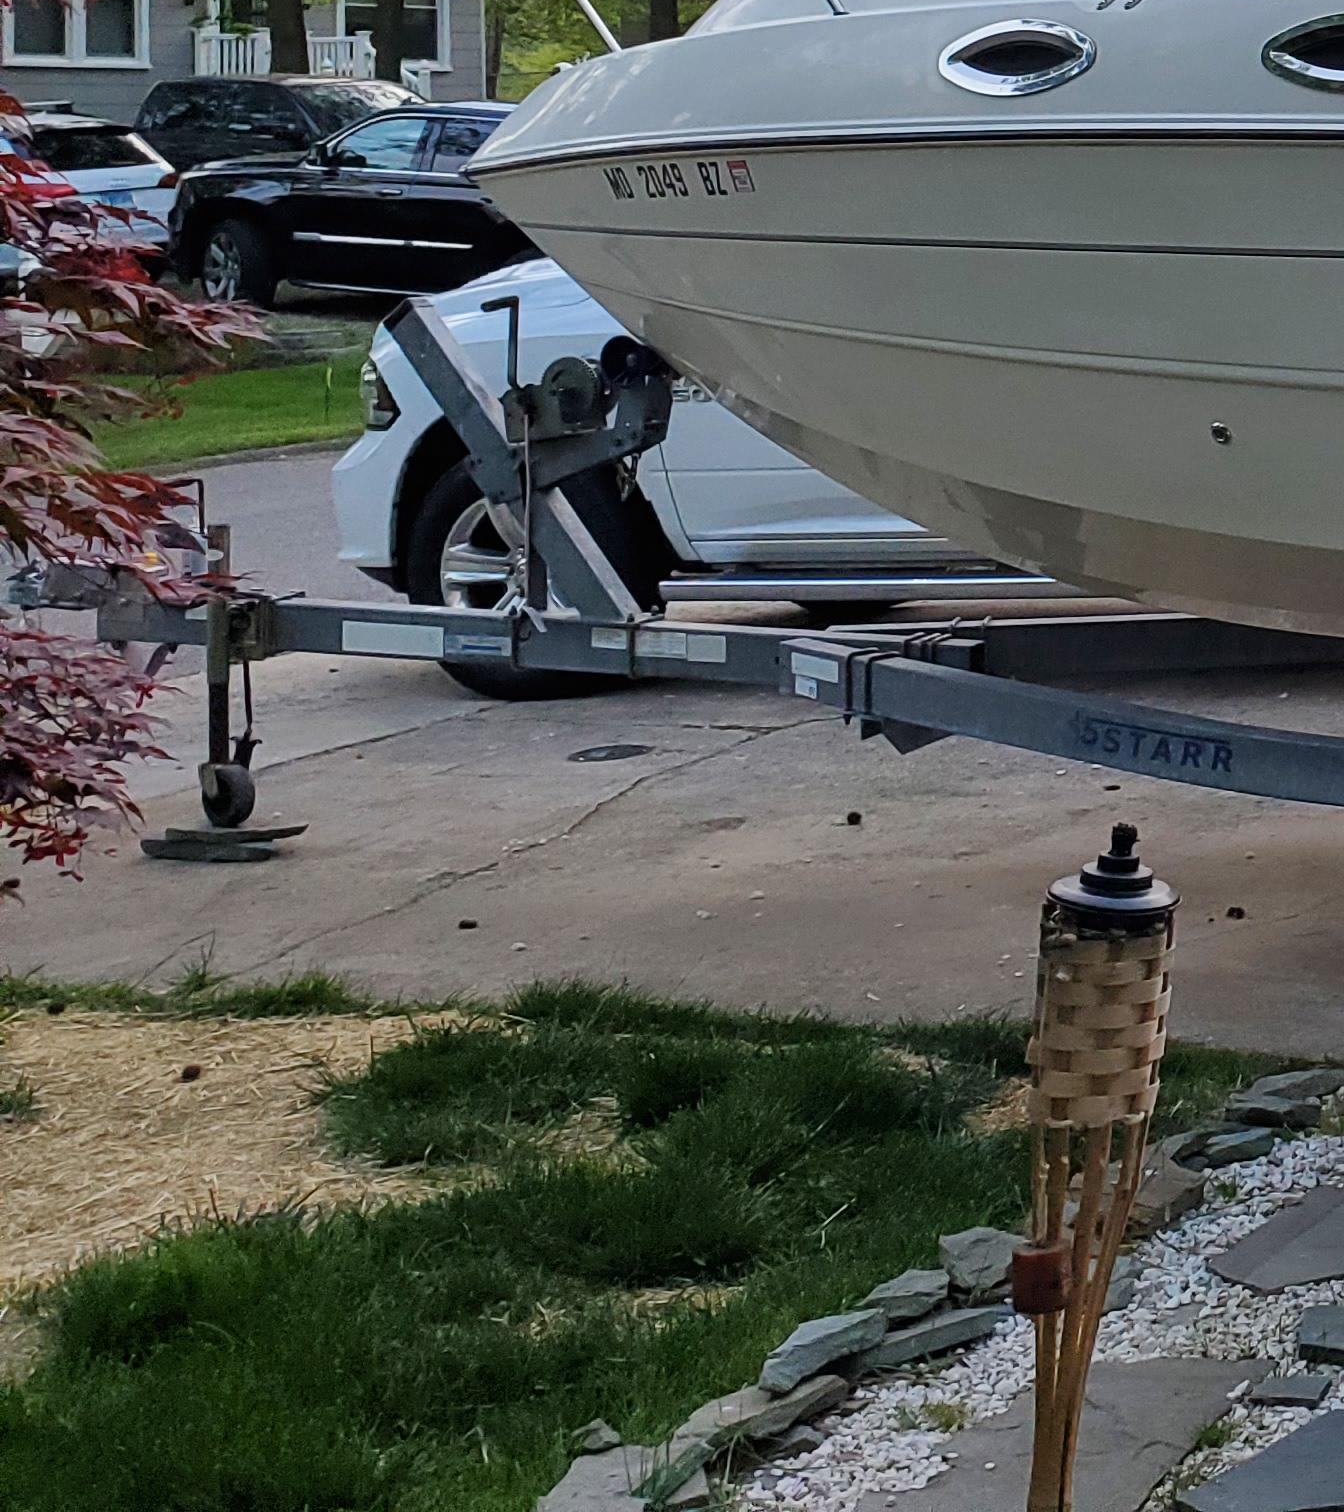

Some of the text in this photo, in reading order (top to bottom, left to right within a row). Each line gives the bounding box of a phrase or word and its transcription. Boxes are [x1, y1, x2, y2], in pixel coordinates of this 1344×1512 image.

[603, 165, 635, 200] MD
[636, 162, 690, 199] 2049
[697, 161, 729, 196] BZ
